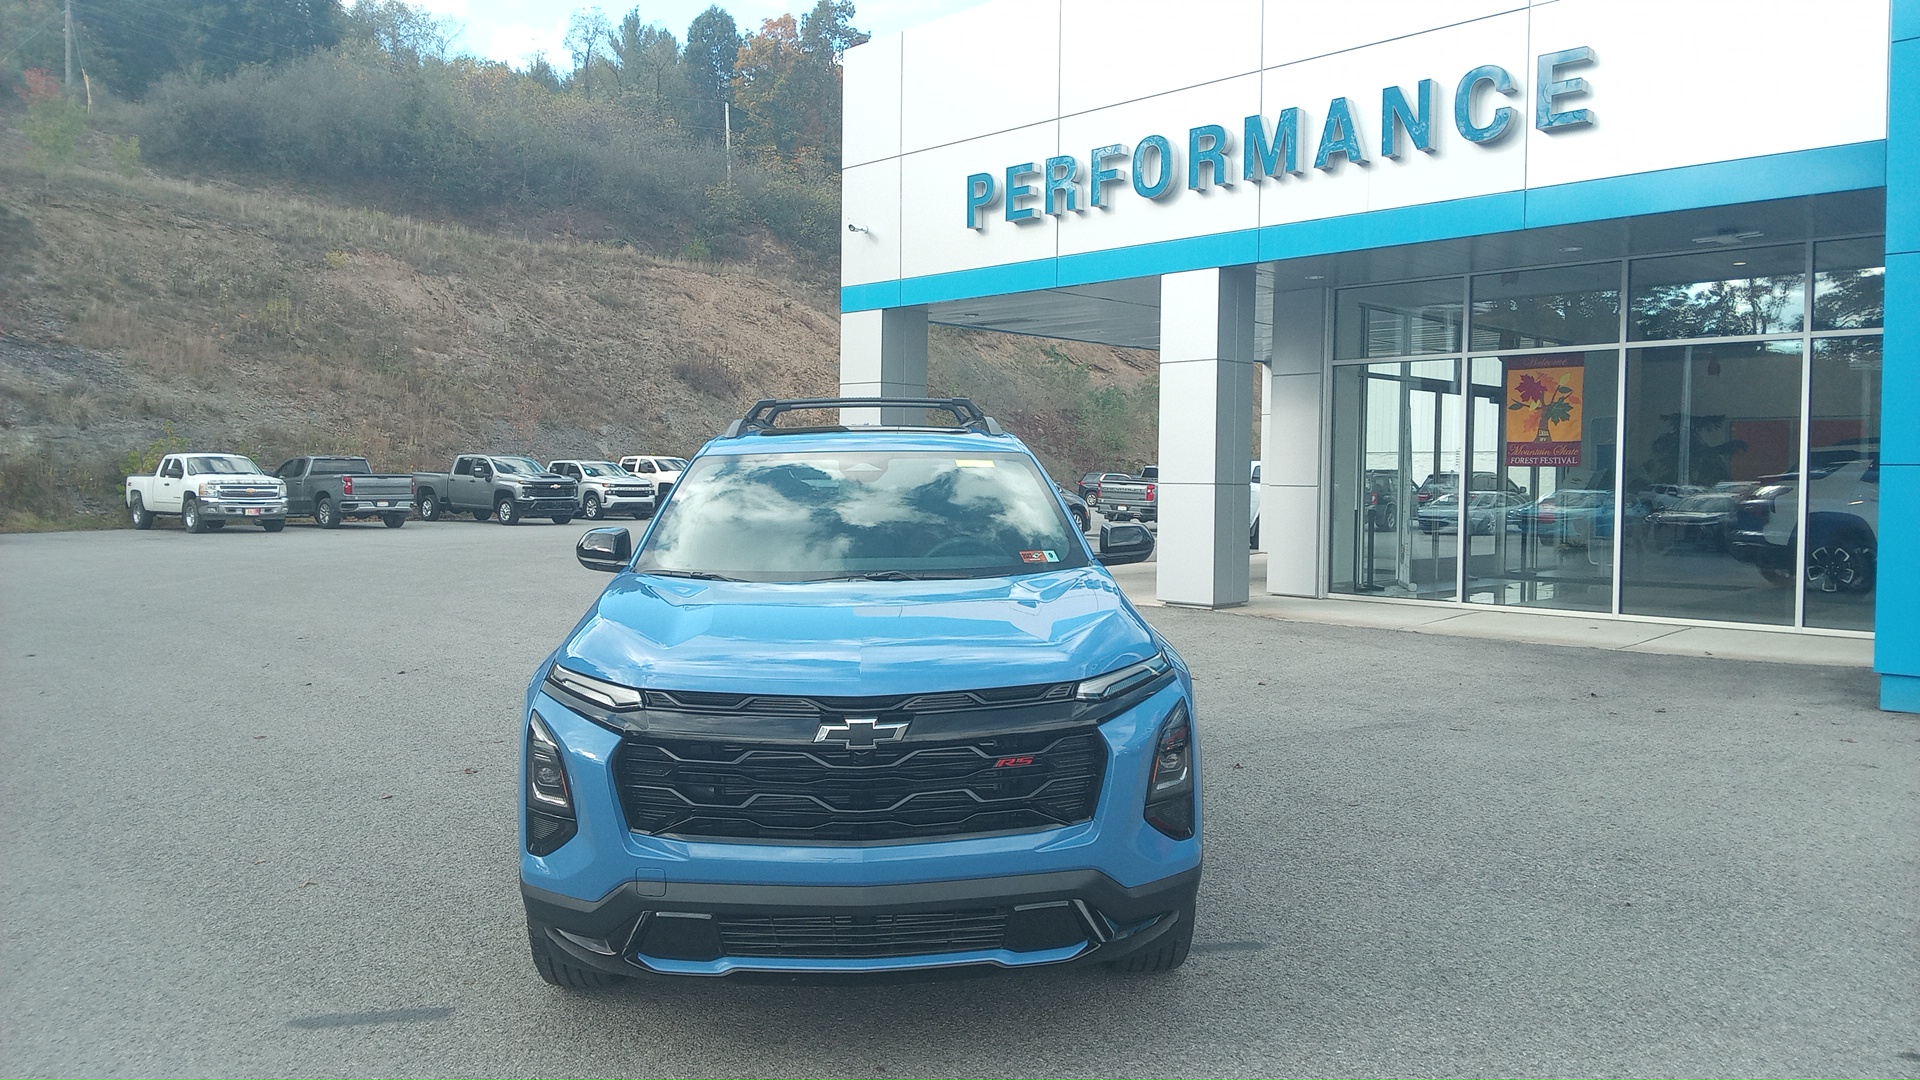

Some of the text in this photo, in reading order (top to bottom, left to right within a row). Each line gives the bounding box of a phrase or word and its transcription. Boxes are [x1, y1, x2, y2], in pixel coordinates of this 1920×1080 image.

[966, 45, 1596, 230] PERFORMANCE
[1508, 444, 1579, 456] Mountain State
[1510, 456, 1578, 464] FOREST FESTIVAL
[994, 755, 1035, 768] RS
